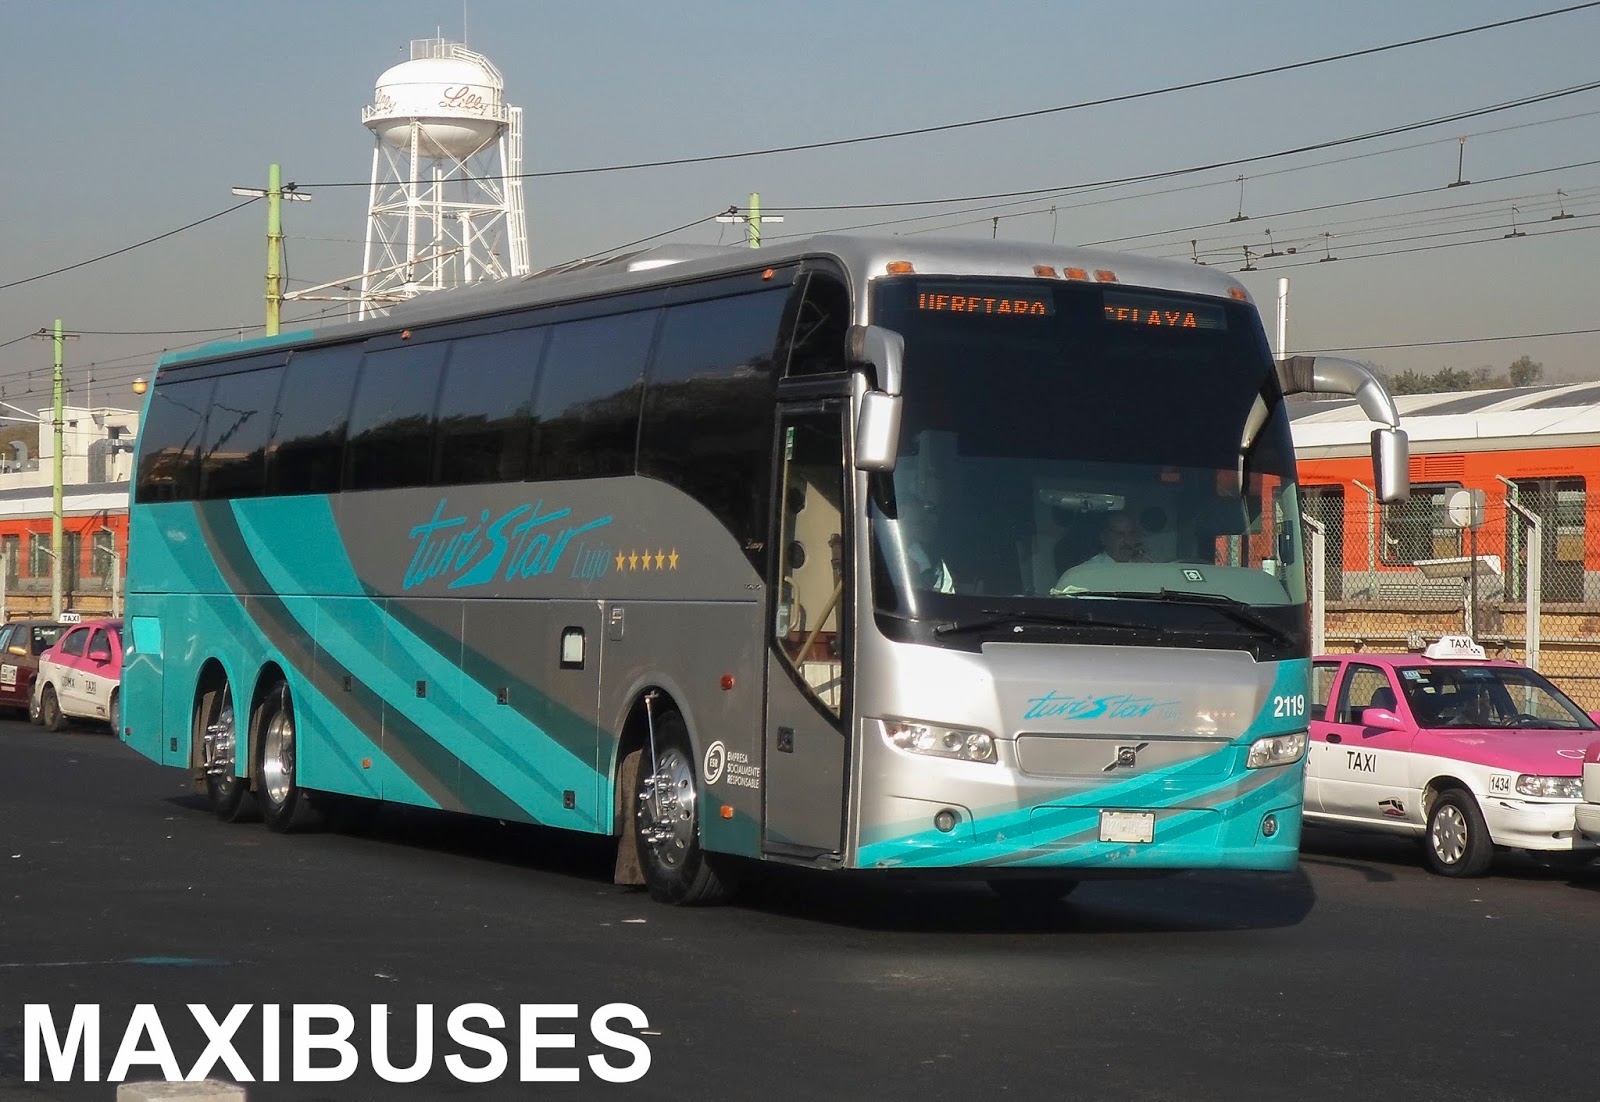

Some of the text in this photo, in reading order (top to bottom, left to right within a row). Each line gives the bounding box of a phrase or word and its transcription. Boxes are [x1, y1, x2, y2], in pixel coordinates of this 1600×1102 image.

[439, 86, 489, 115] Lilly
[1449, 638, 1472, 649] TAXI
[1273, 694, 1305, 718] 2119
[709, 758, 719, 768] ESR
[727, 751, 748, 763] EMPRESA
[1346, 751, 1377, 773] TAXI
[727, 763, 760, 777] SOCIALMENTE
[727, 774, 759, 788] RESPONSABLE
[1490, 775, 1510, 792] 1434
